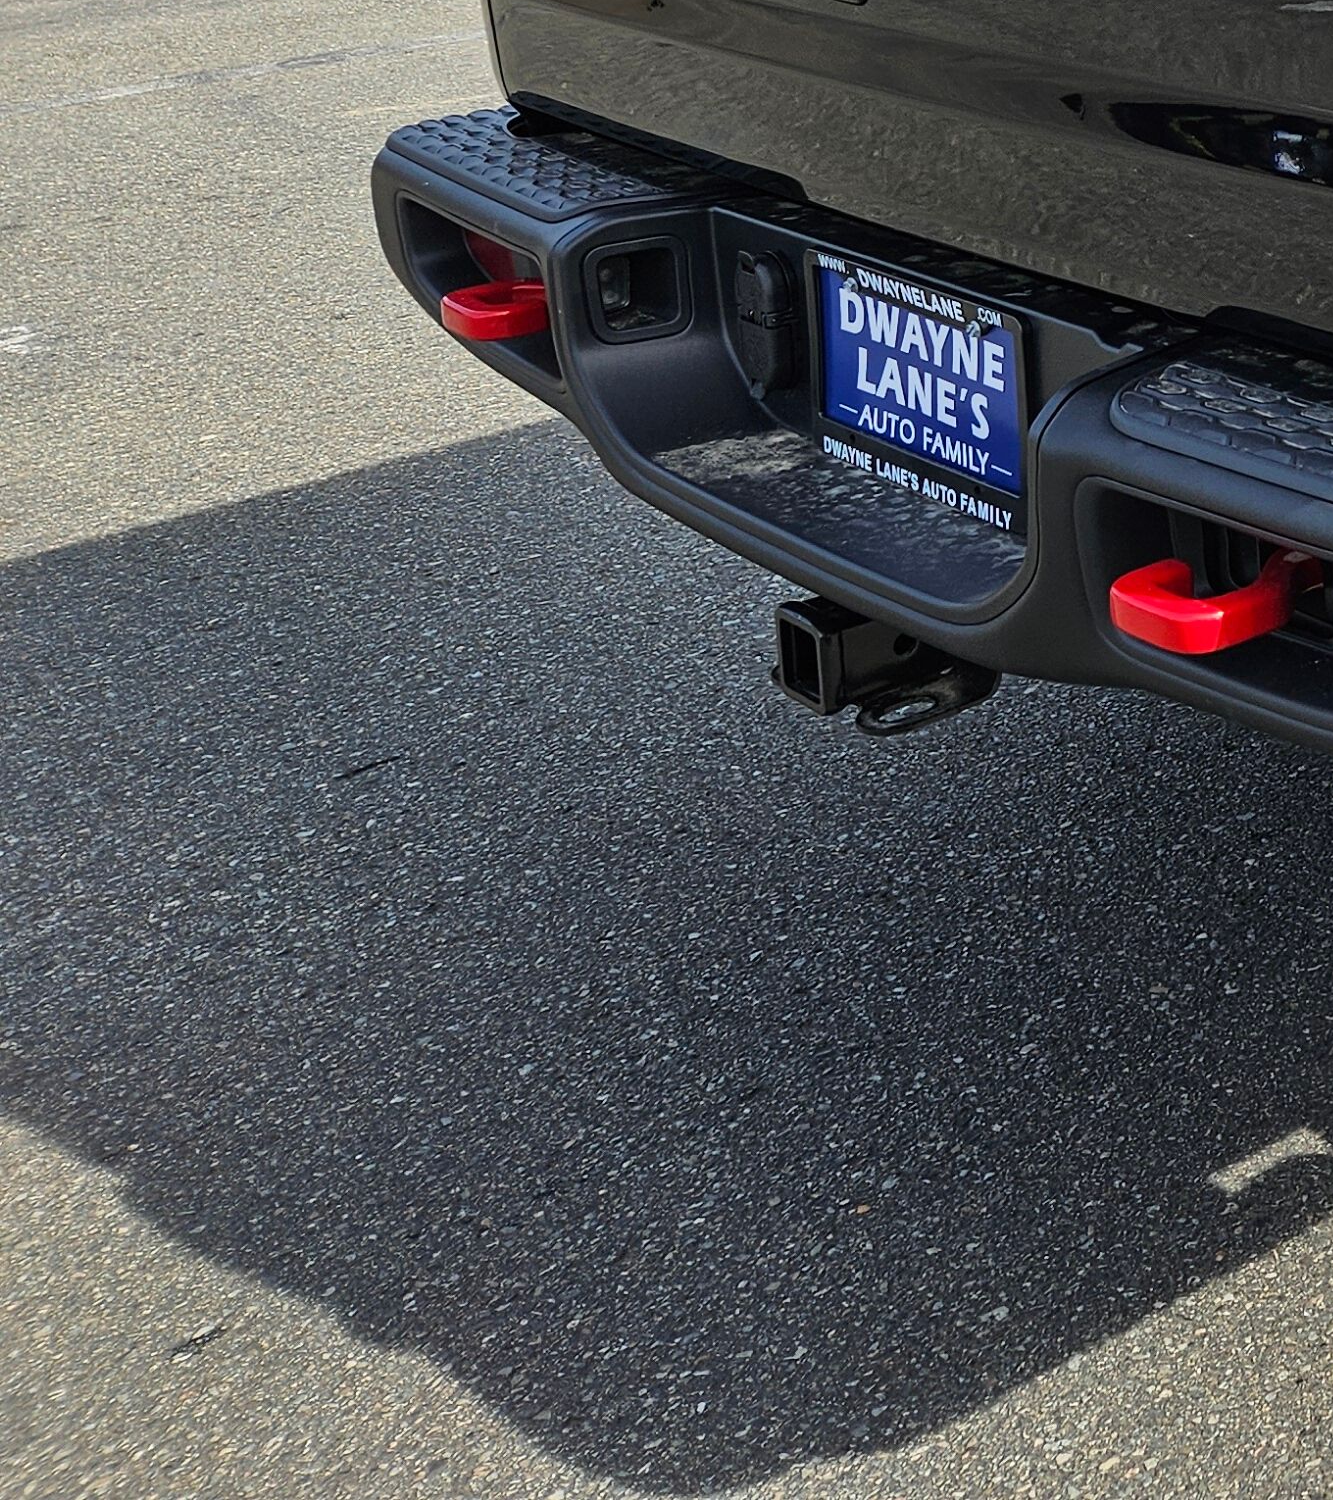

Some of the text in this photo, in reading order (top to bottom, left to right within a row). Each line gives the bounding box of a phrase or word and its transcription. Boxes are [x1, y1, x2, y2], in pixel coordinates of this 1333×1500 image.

[817, 253, 1003, 329] WWW. DWAYNELANE .COM
[839, 287, 1005, 392] DWAYNE
[856, 346, 990, 440] LANE'S
[858, 403, 990, 476] AUTO FAMILY
[823, 435, 1012, 531] DWAYNE LANE'S AUTO FAMILY
